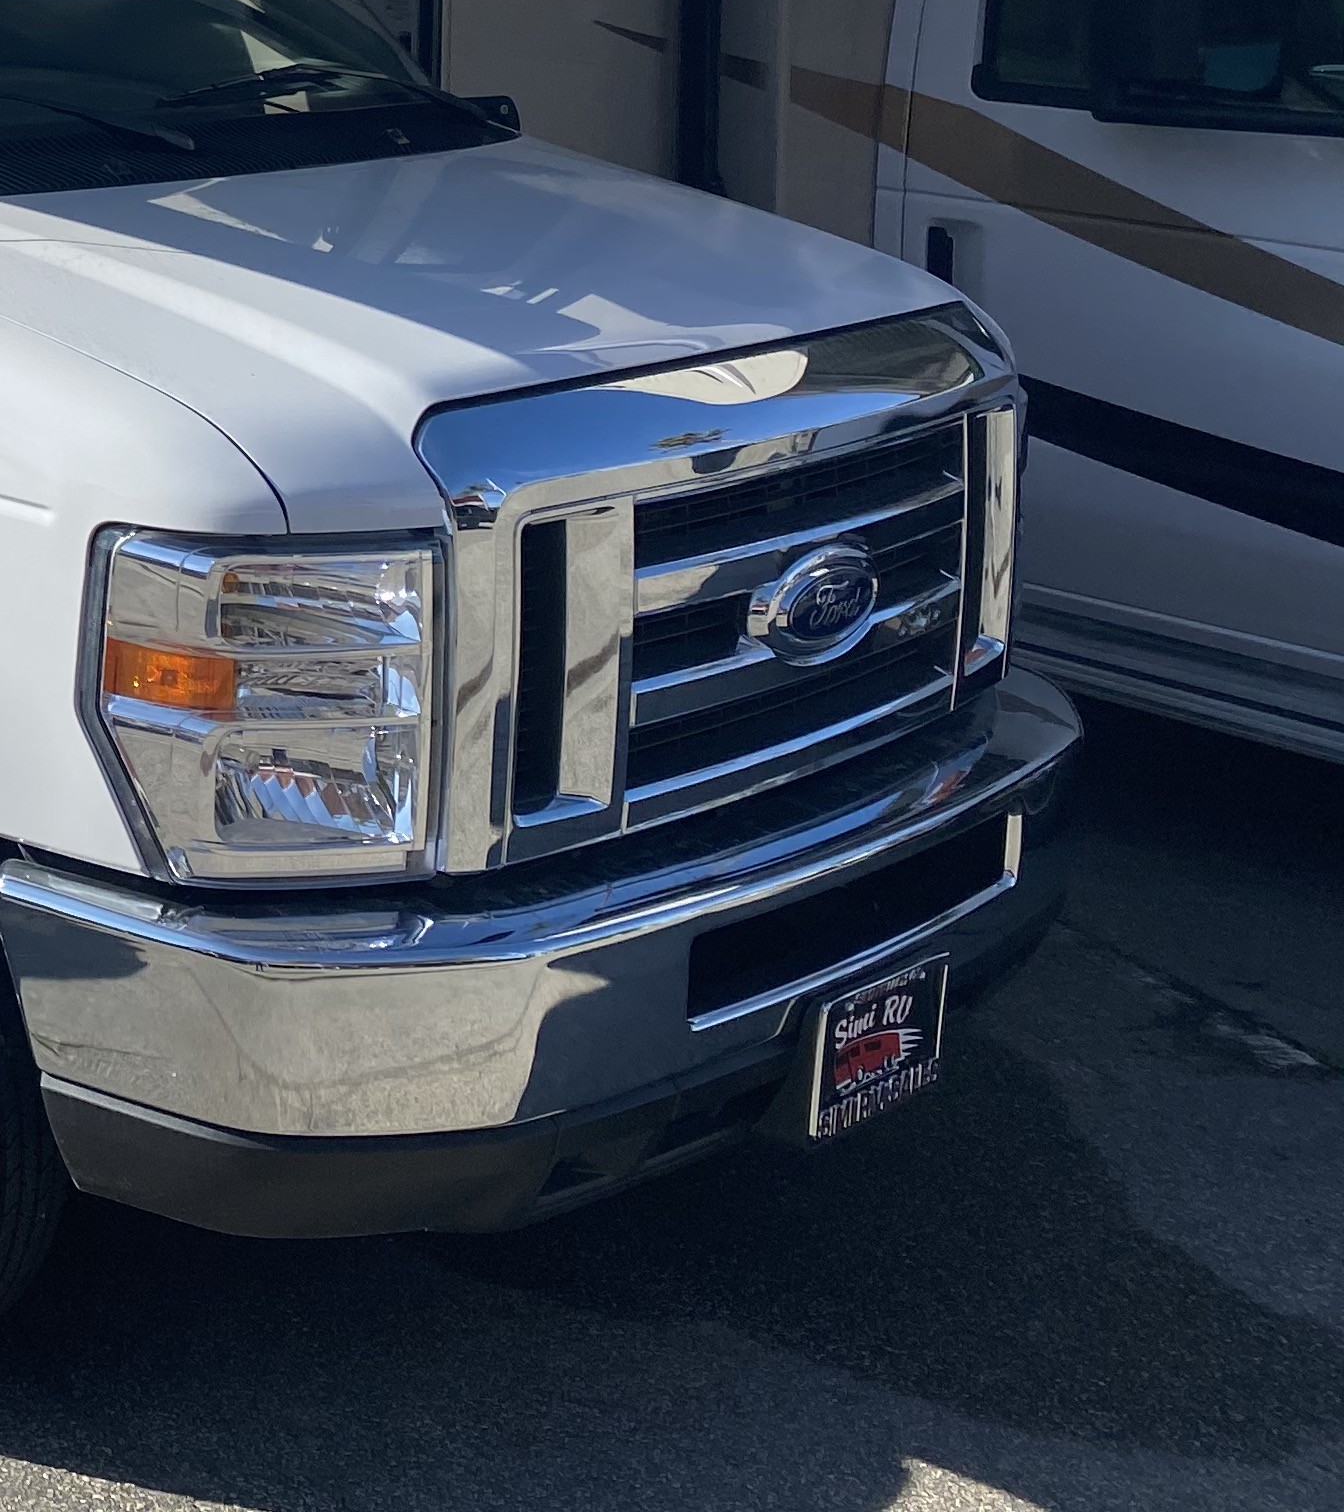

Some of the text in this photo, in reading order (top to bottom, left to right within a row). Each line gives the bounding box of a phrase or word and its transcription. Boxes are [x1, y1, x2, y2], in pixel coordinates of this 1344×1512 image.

[809, 580, 862, 626] Ford
[834, 994, 914, 1050] Simi RV
